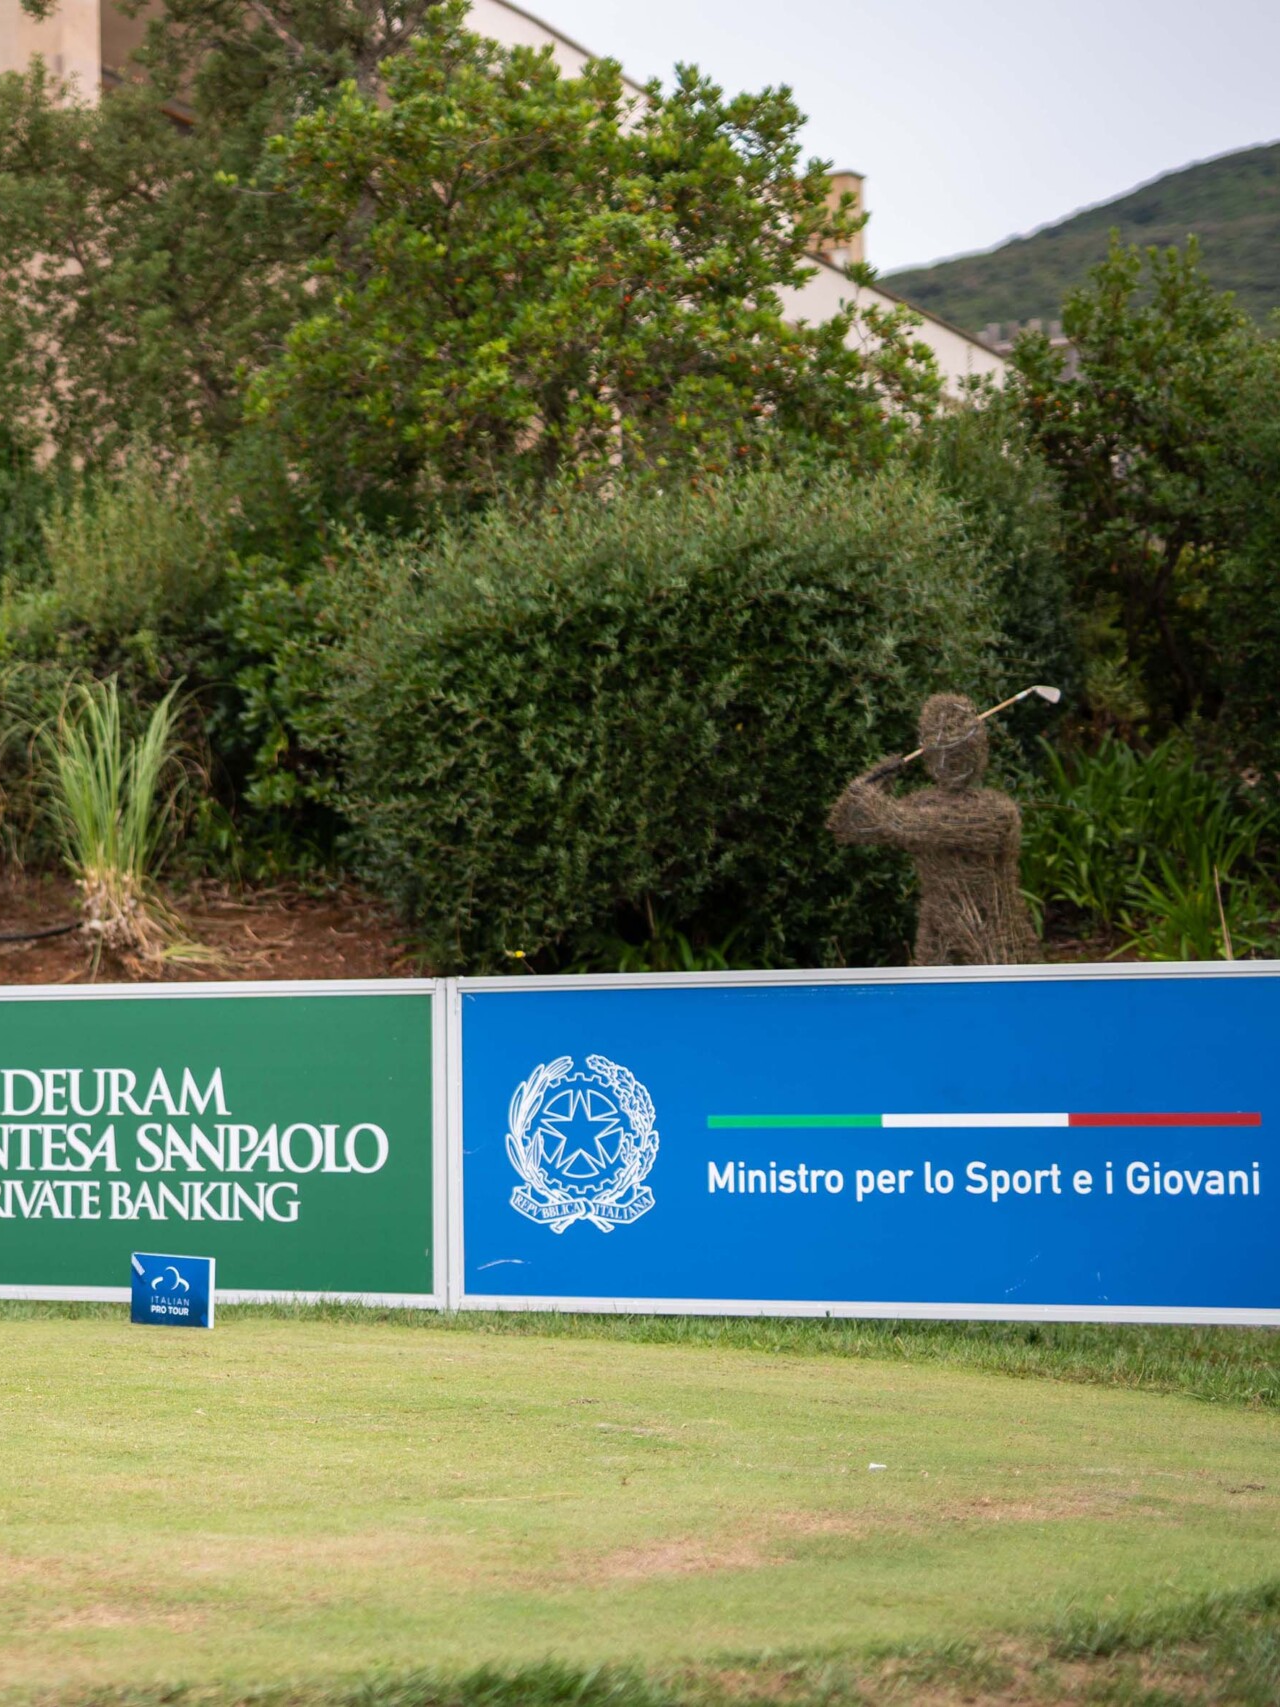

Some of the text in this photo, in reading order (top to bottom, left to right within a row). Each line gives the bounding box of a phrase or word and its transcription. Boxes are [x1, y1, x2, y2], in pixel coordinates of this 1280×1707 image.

[135, 1122, 390, 1174] SANPAOLO
[708, 1161, 1261, 1203] Ministro per lo Sport e i Giovani
[109, 1181, 301, 1223] BANKING
[595, 1196, 651, 1220] ITALIANA
[151, 1296, 190, 1306] ITALIAN
[151, 1305, 189, 1316] PRO TOUR
